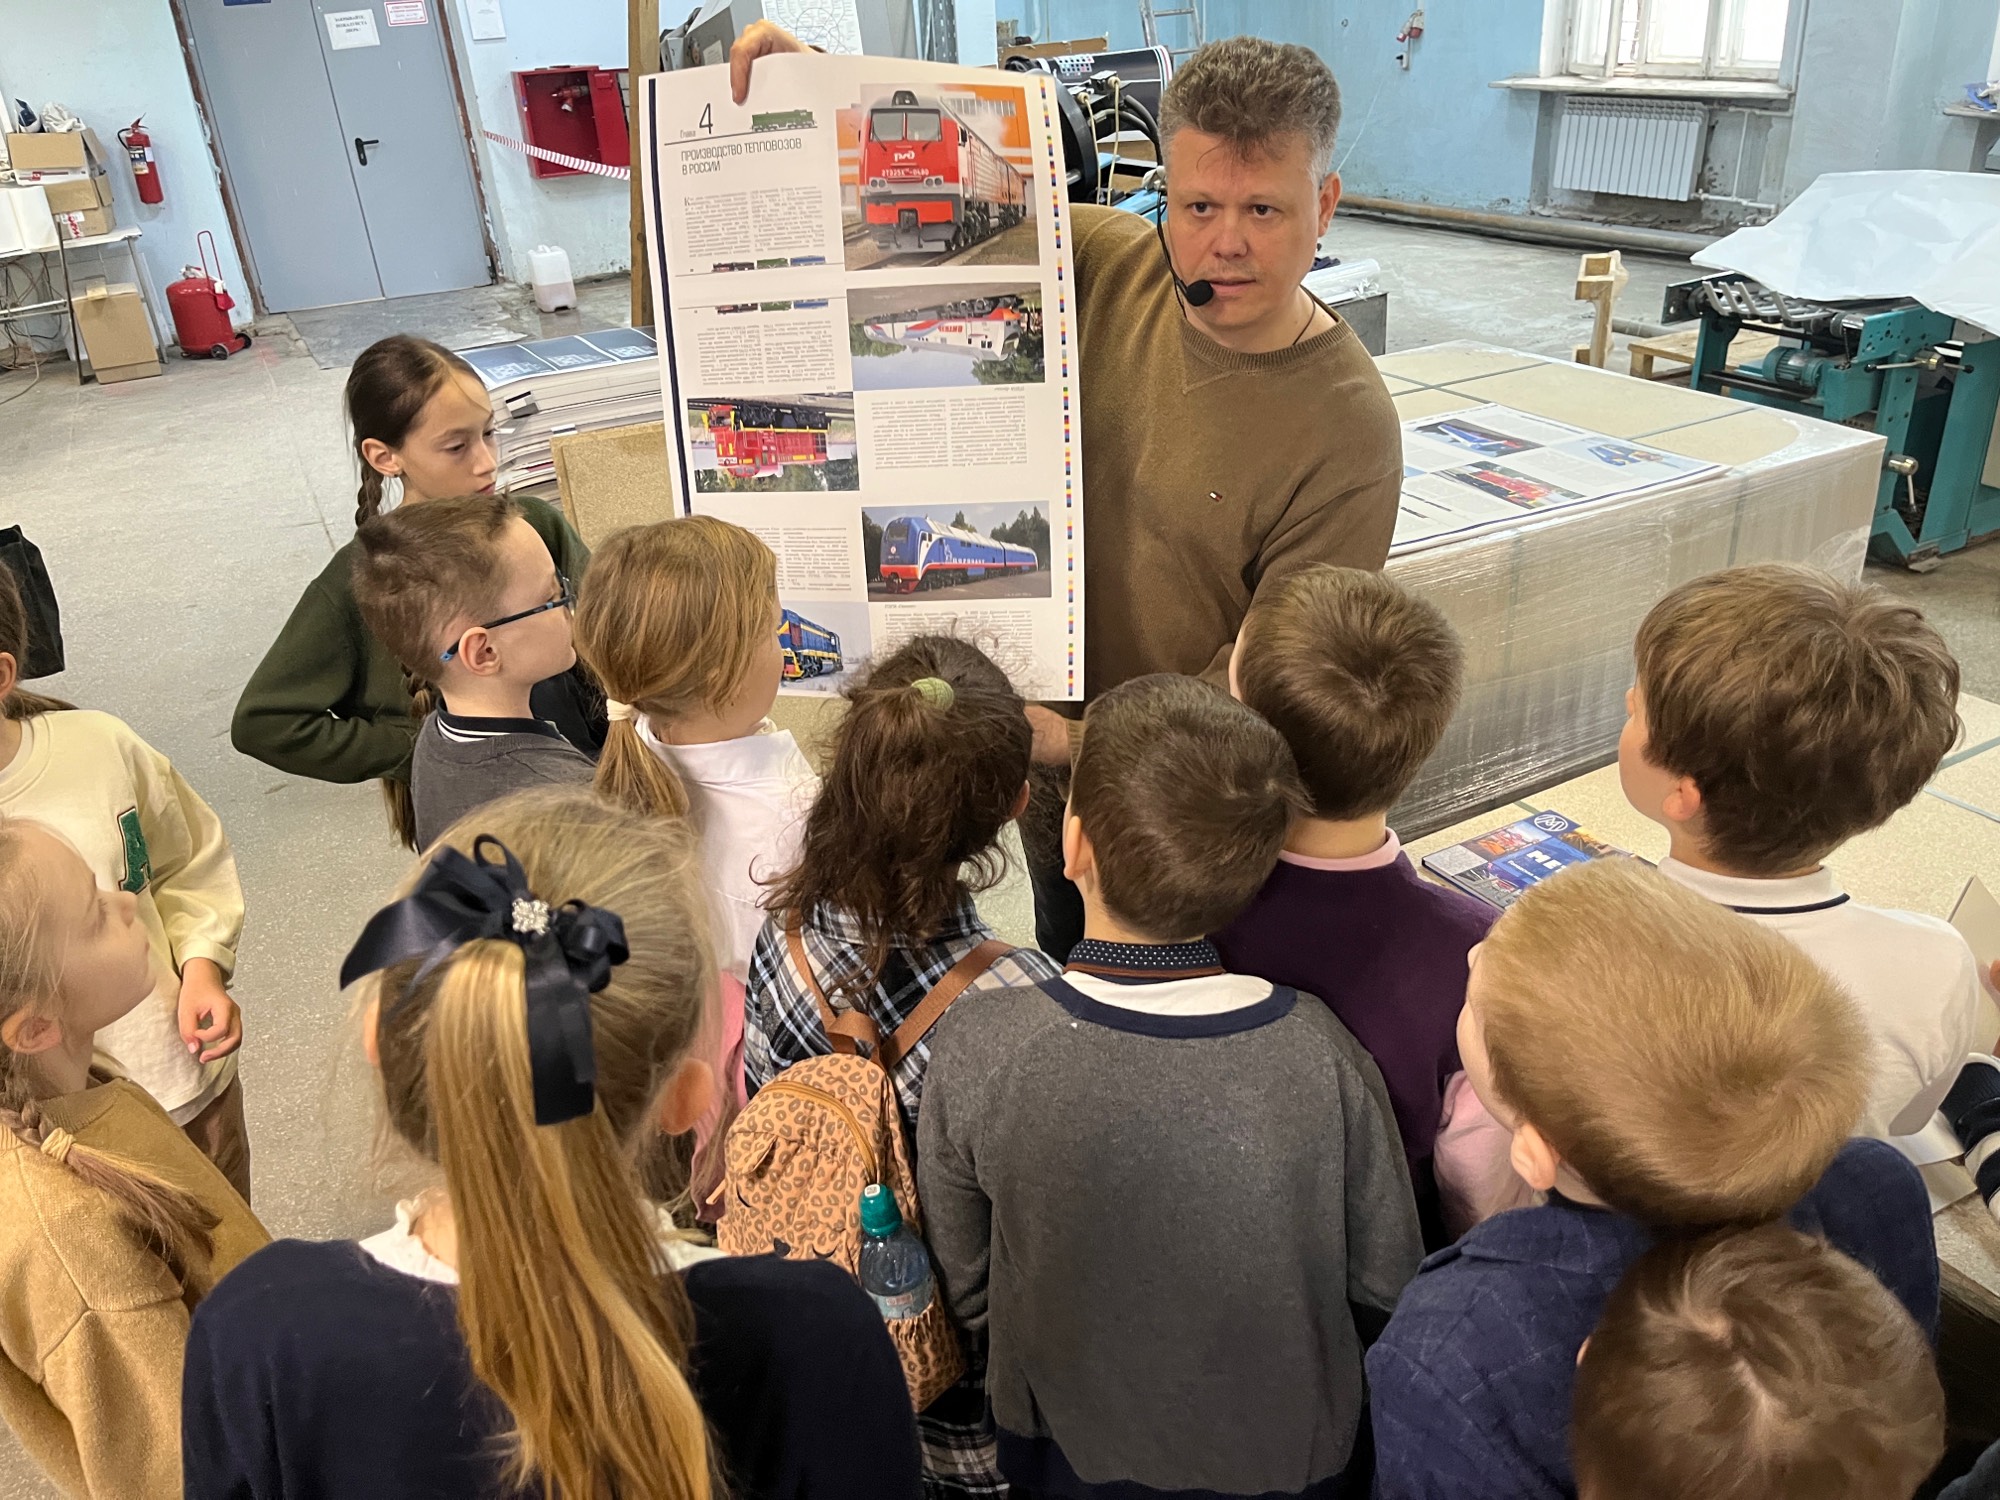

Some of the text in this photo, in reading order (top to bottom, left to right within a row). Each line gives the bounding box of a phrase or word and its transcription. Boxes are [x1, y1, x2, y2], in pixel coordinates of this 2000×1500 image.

[698, 102, 714, 134] 4
[681, 137, 802, 162] ПРОИЗВОДСТВО ТЕПЛОВОЗОВ
[681, 161, 721, 175] В РОССИИ
